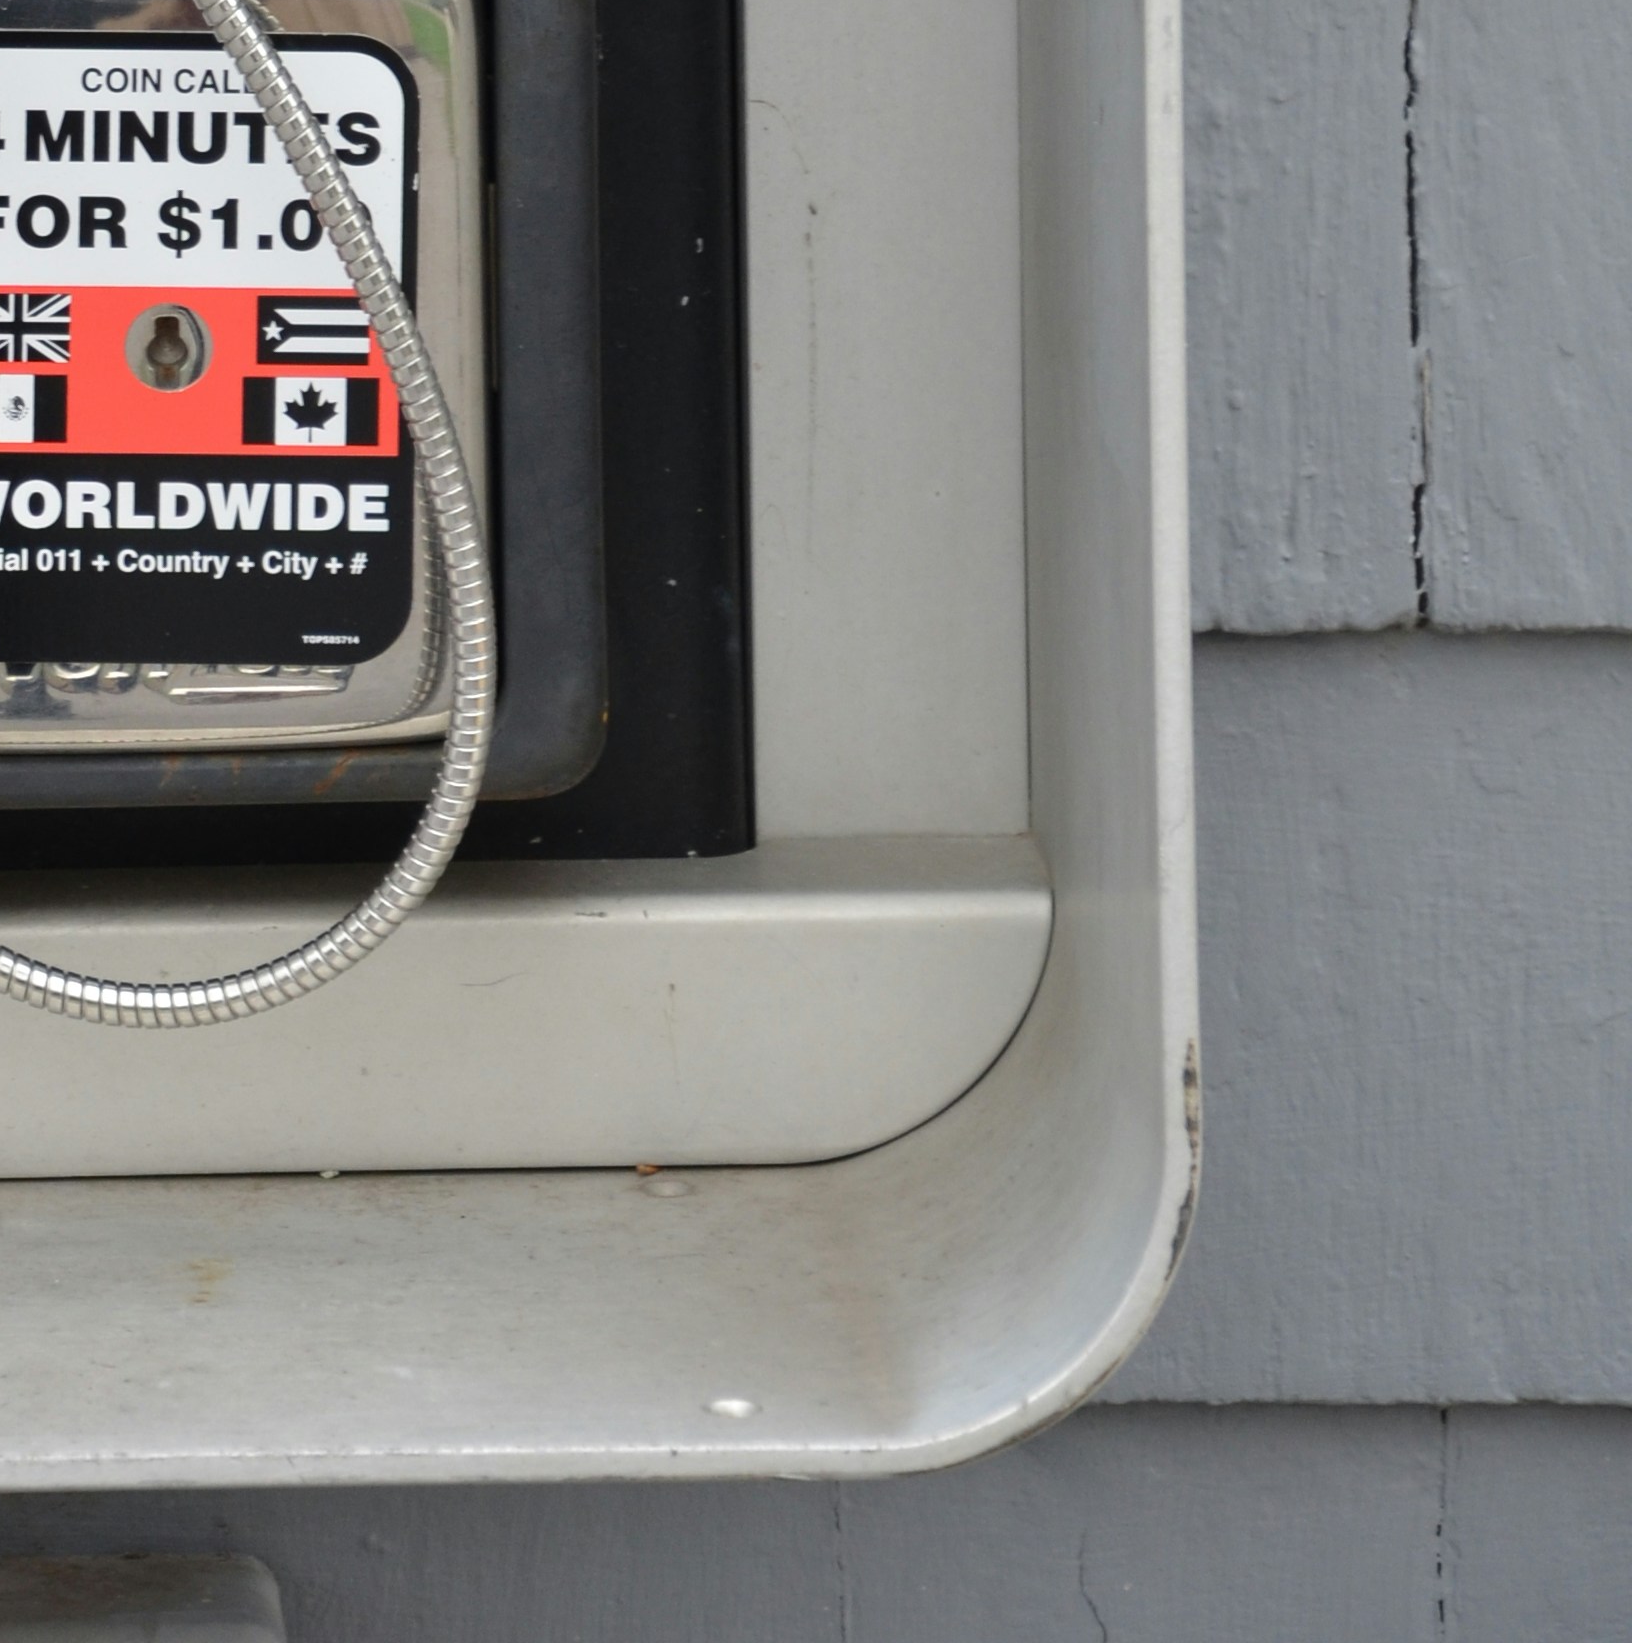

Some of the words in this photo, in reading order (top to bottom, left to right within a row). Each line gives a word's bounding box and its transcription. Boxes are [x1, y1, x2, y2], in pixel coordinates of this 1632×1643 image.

[81, 67, 162, 94] COIN
[24, 110, 382, 166] MINUTS
[157, 190, 372, 259] $1.0
[36, 548, 82, 572] 011
[91, 555, 110, 572] +
[117, 549, 230, 580] Country
[237, 555, 255, 573] +
[261, 550, 318, 580] City
[325, 557, 344, 574] +
[349, 552, 369, 574] #
